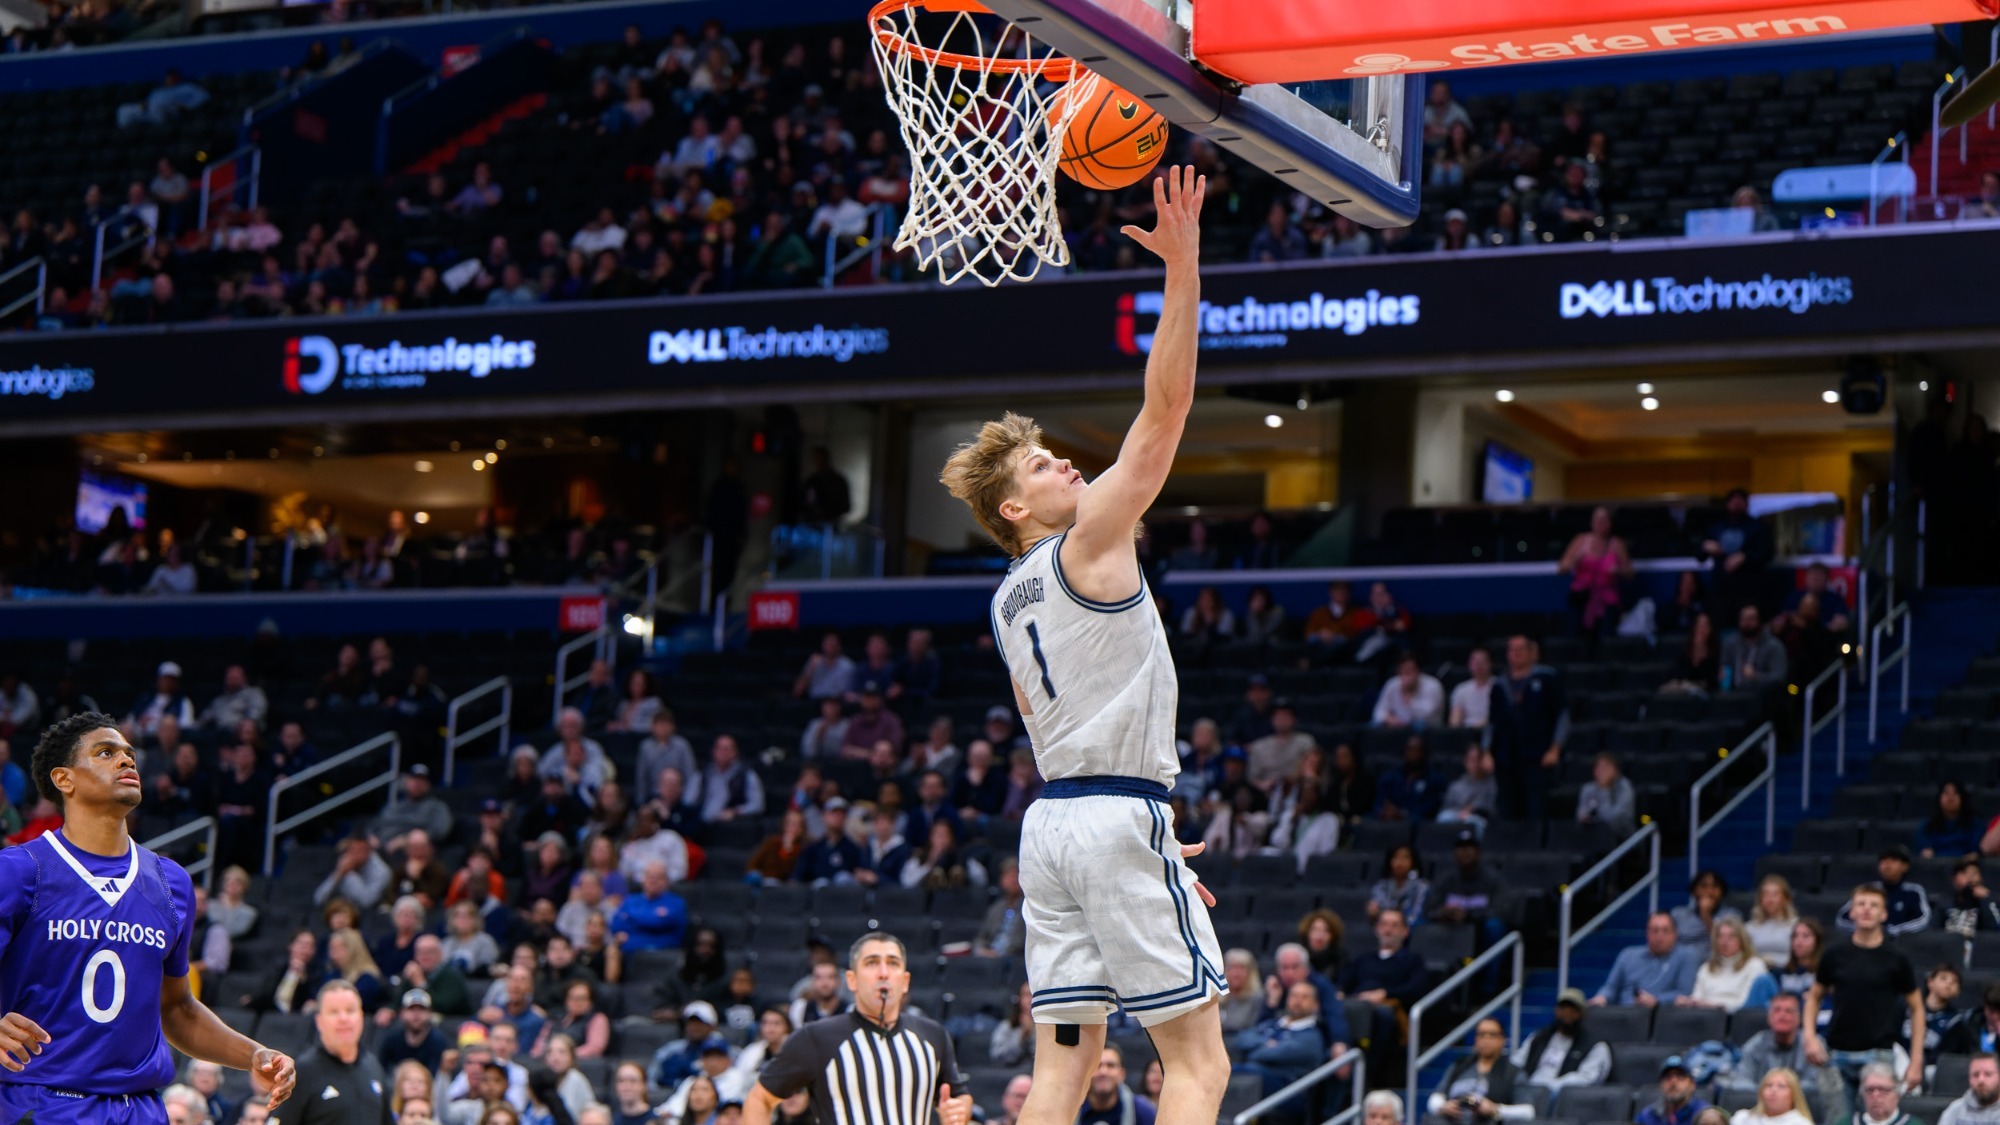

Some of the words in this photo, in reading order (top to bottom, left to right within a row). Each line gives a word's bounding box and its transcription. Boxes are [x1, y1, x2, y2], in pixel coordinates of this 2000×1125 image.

[1450, 33, 1650, 65] State
[1650, 15, 1848, 47] Farm
[1136, 117, 1168, 155] ELIT
[1559, 278, 1655, 319] DELL
[1651, 271, 1853, 314] Technologies
[342, 334, 536, 377] Technologies
[648, 327, 728, 364] DELL
[723, 323, 890, 363] Technologies
[1000, 576, 1045, 628] BRUMBAUGH
[1024, 618, 1057, 699] 1
[48, 919, 101, 941] HOLY
[104, 921, 166, 949] CROSS
[81, 949, 126, 1023] 0
